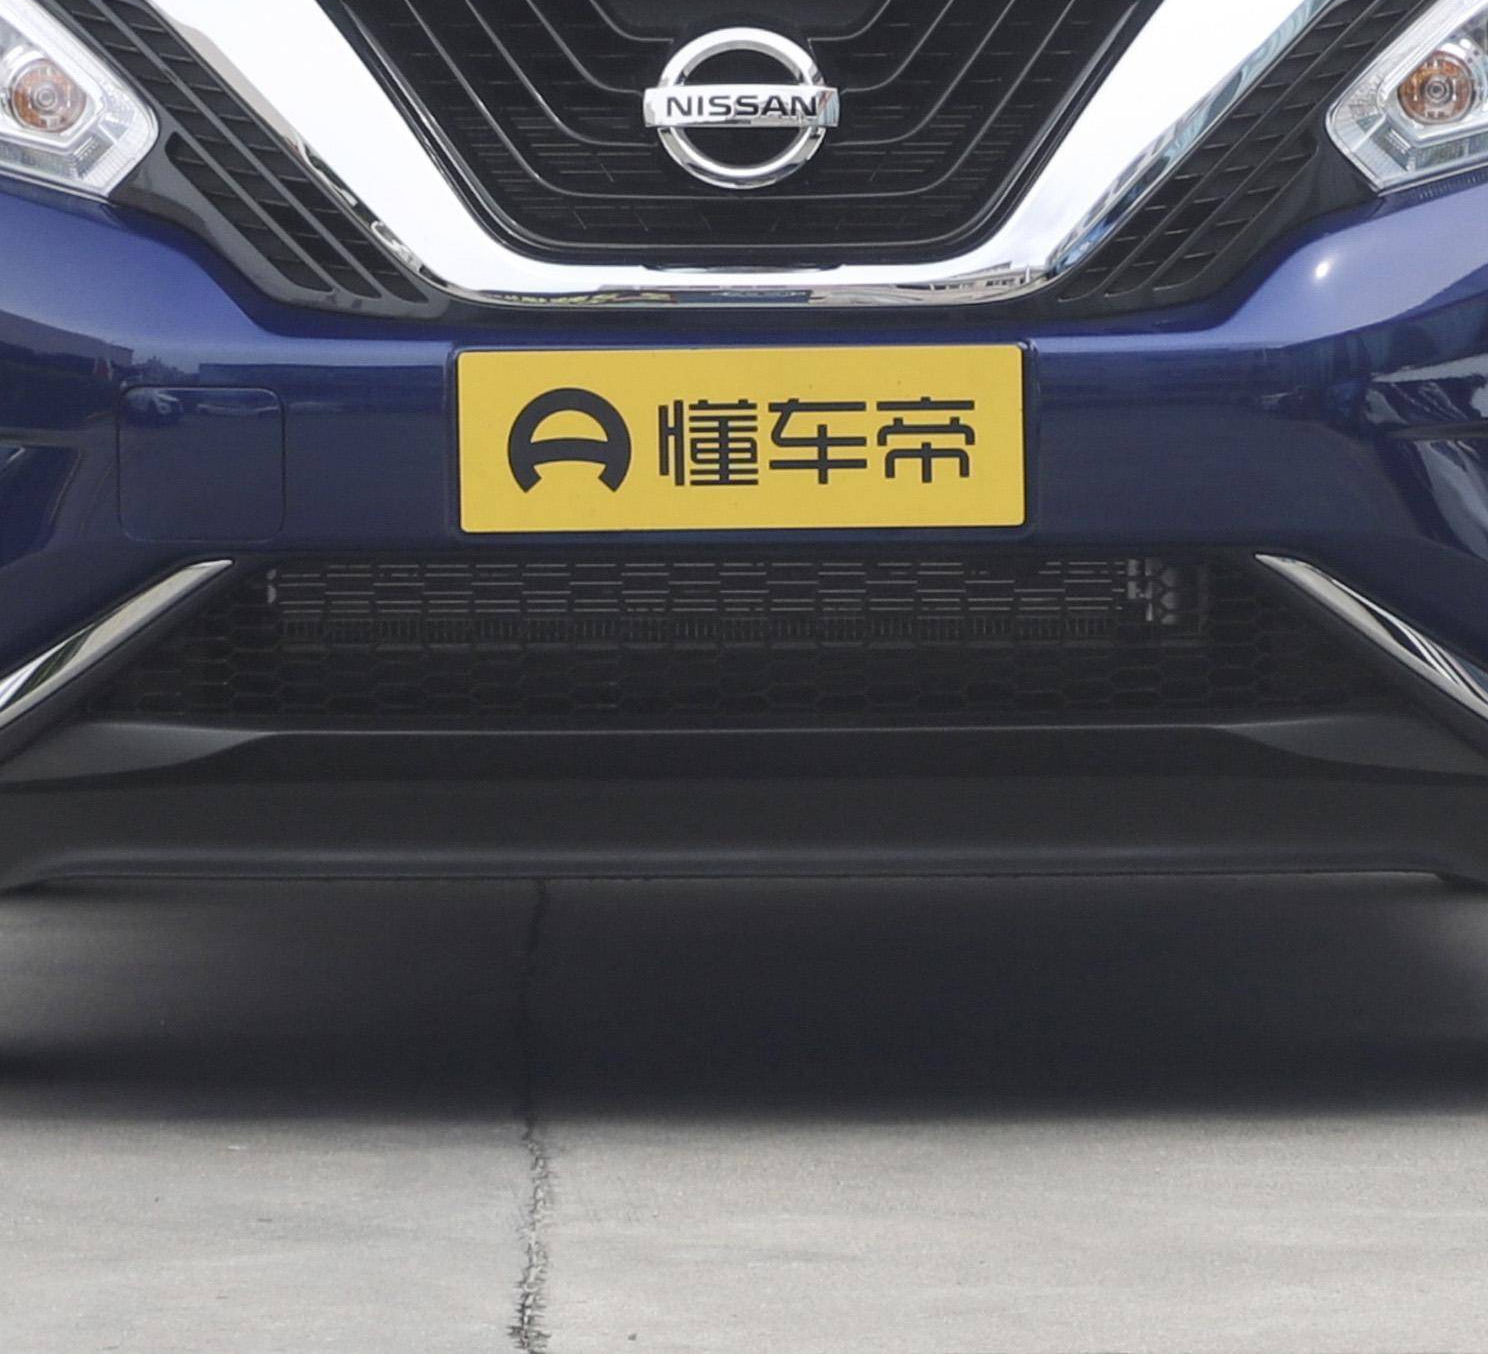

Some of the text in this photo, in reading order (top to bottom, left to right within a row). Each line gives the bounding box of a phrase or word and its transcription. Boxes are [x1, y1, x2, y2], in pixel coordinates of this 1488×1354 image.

[666, 95, 817, 117] NISSAN
[658, 396, 975, 487] 懂车帝
